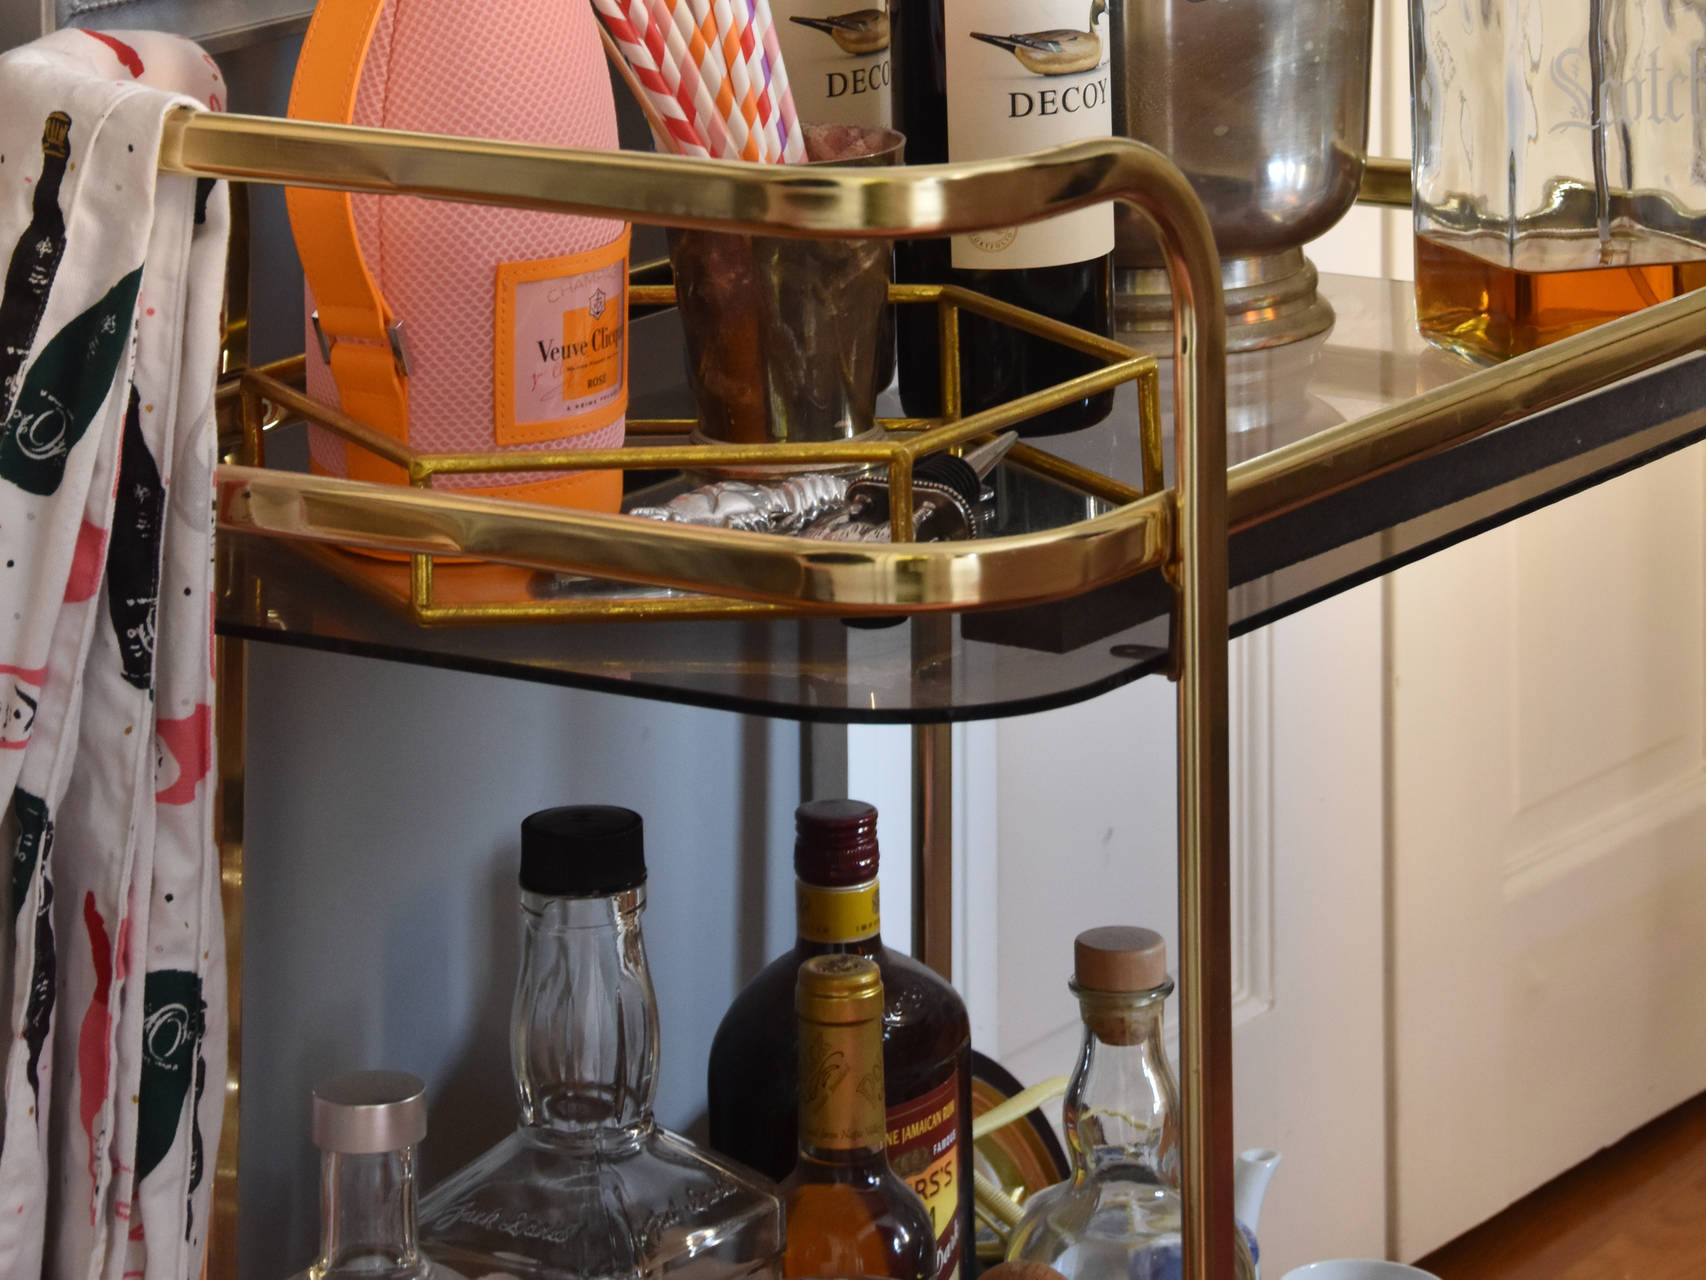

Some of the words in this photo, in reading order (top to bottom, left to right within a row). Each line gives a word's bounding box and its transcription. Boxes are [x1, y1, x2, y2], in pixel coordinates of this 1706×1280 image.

[826, 61, 890, 98] DECO
[1009, 78, 1108, 118] DECOY
[537, 339, 588, 363] Veuve
[886, 1129, 900, 1145] NE
[902, 1110, 942, 1144] JAMAICAN
[914, 1160, 953, 1200] RS'S
